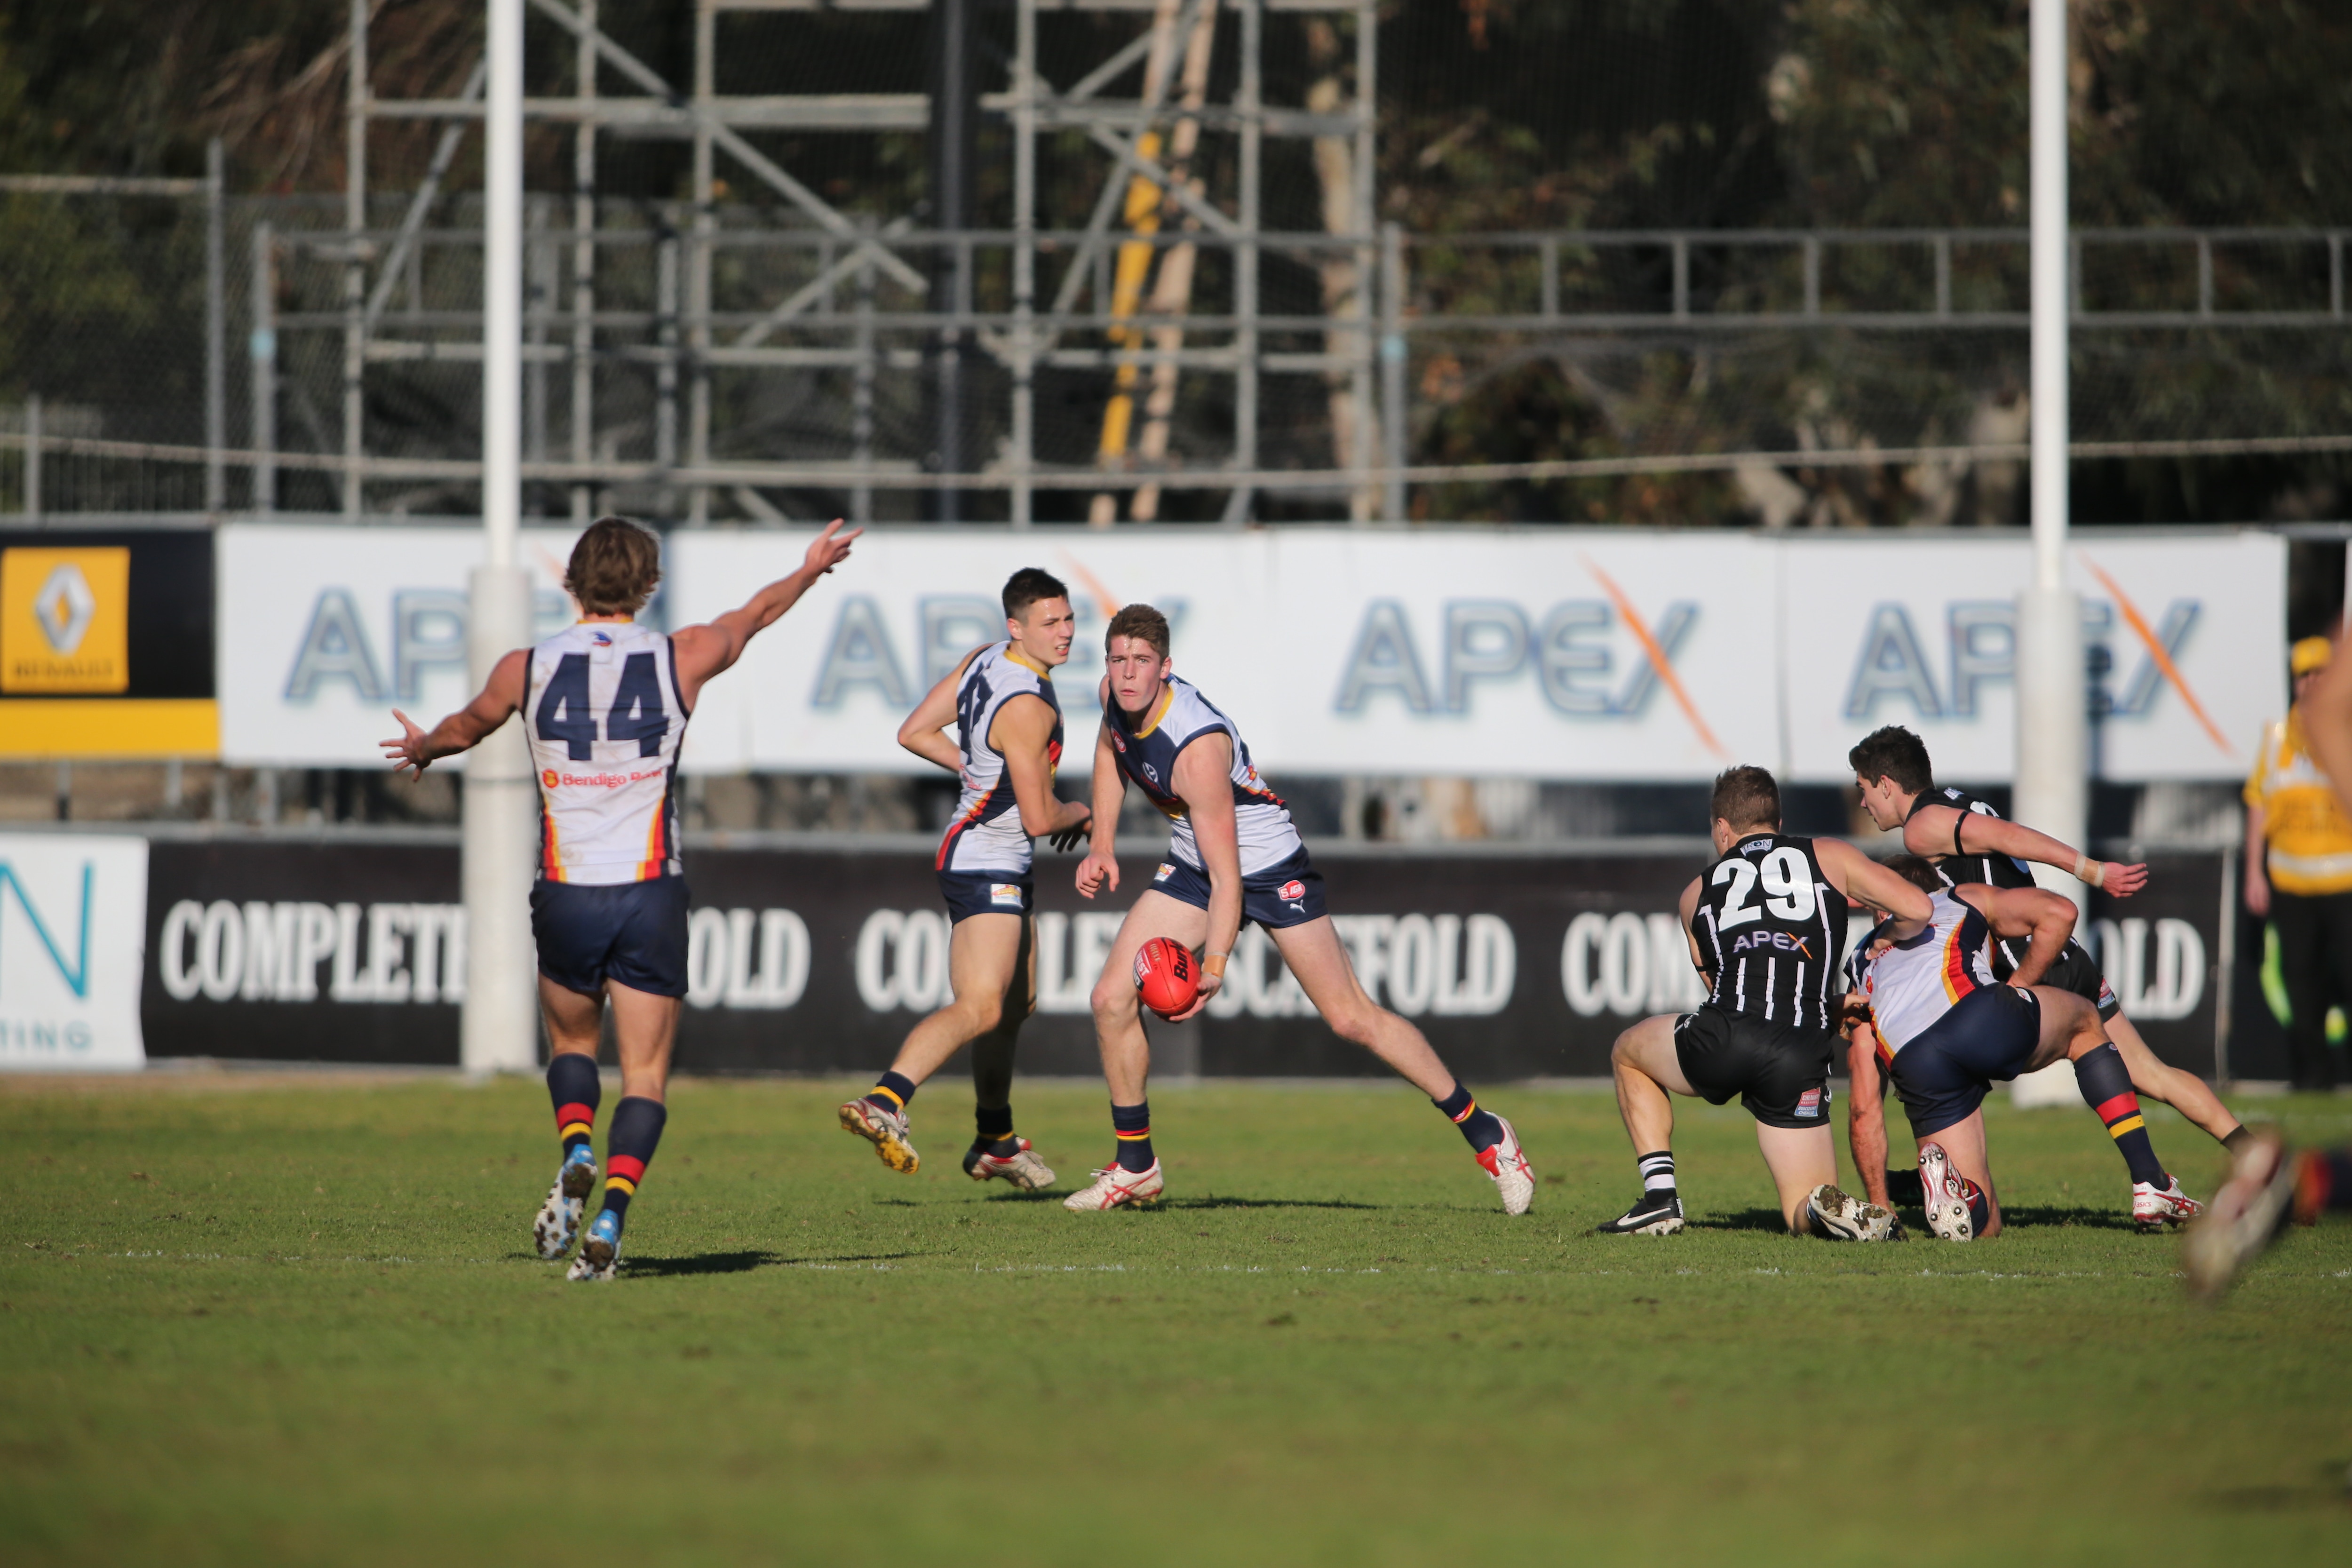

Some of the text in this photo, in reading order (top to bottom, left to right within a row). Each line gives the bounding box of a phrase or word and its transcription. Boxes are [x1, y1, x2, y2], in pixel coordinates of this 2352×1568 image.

[1335, 560, 1726, 748] APEX
[536, 653, 669, 761] 44
[1114, 735, 1125, 749] IGA
[563, 773, 627, 789] Bendigo
[1711, 846, 1816, 932] 29
[1733, 931, 1813, 960] APEX
